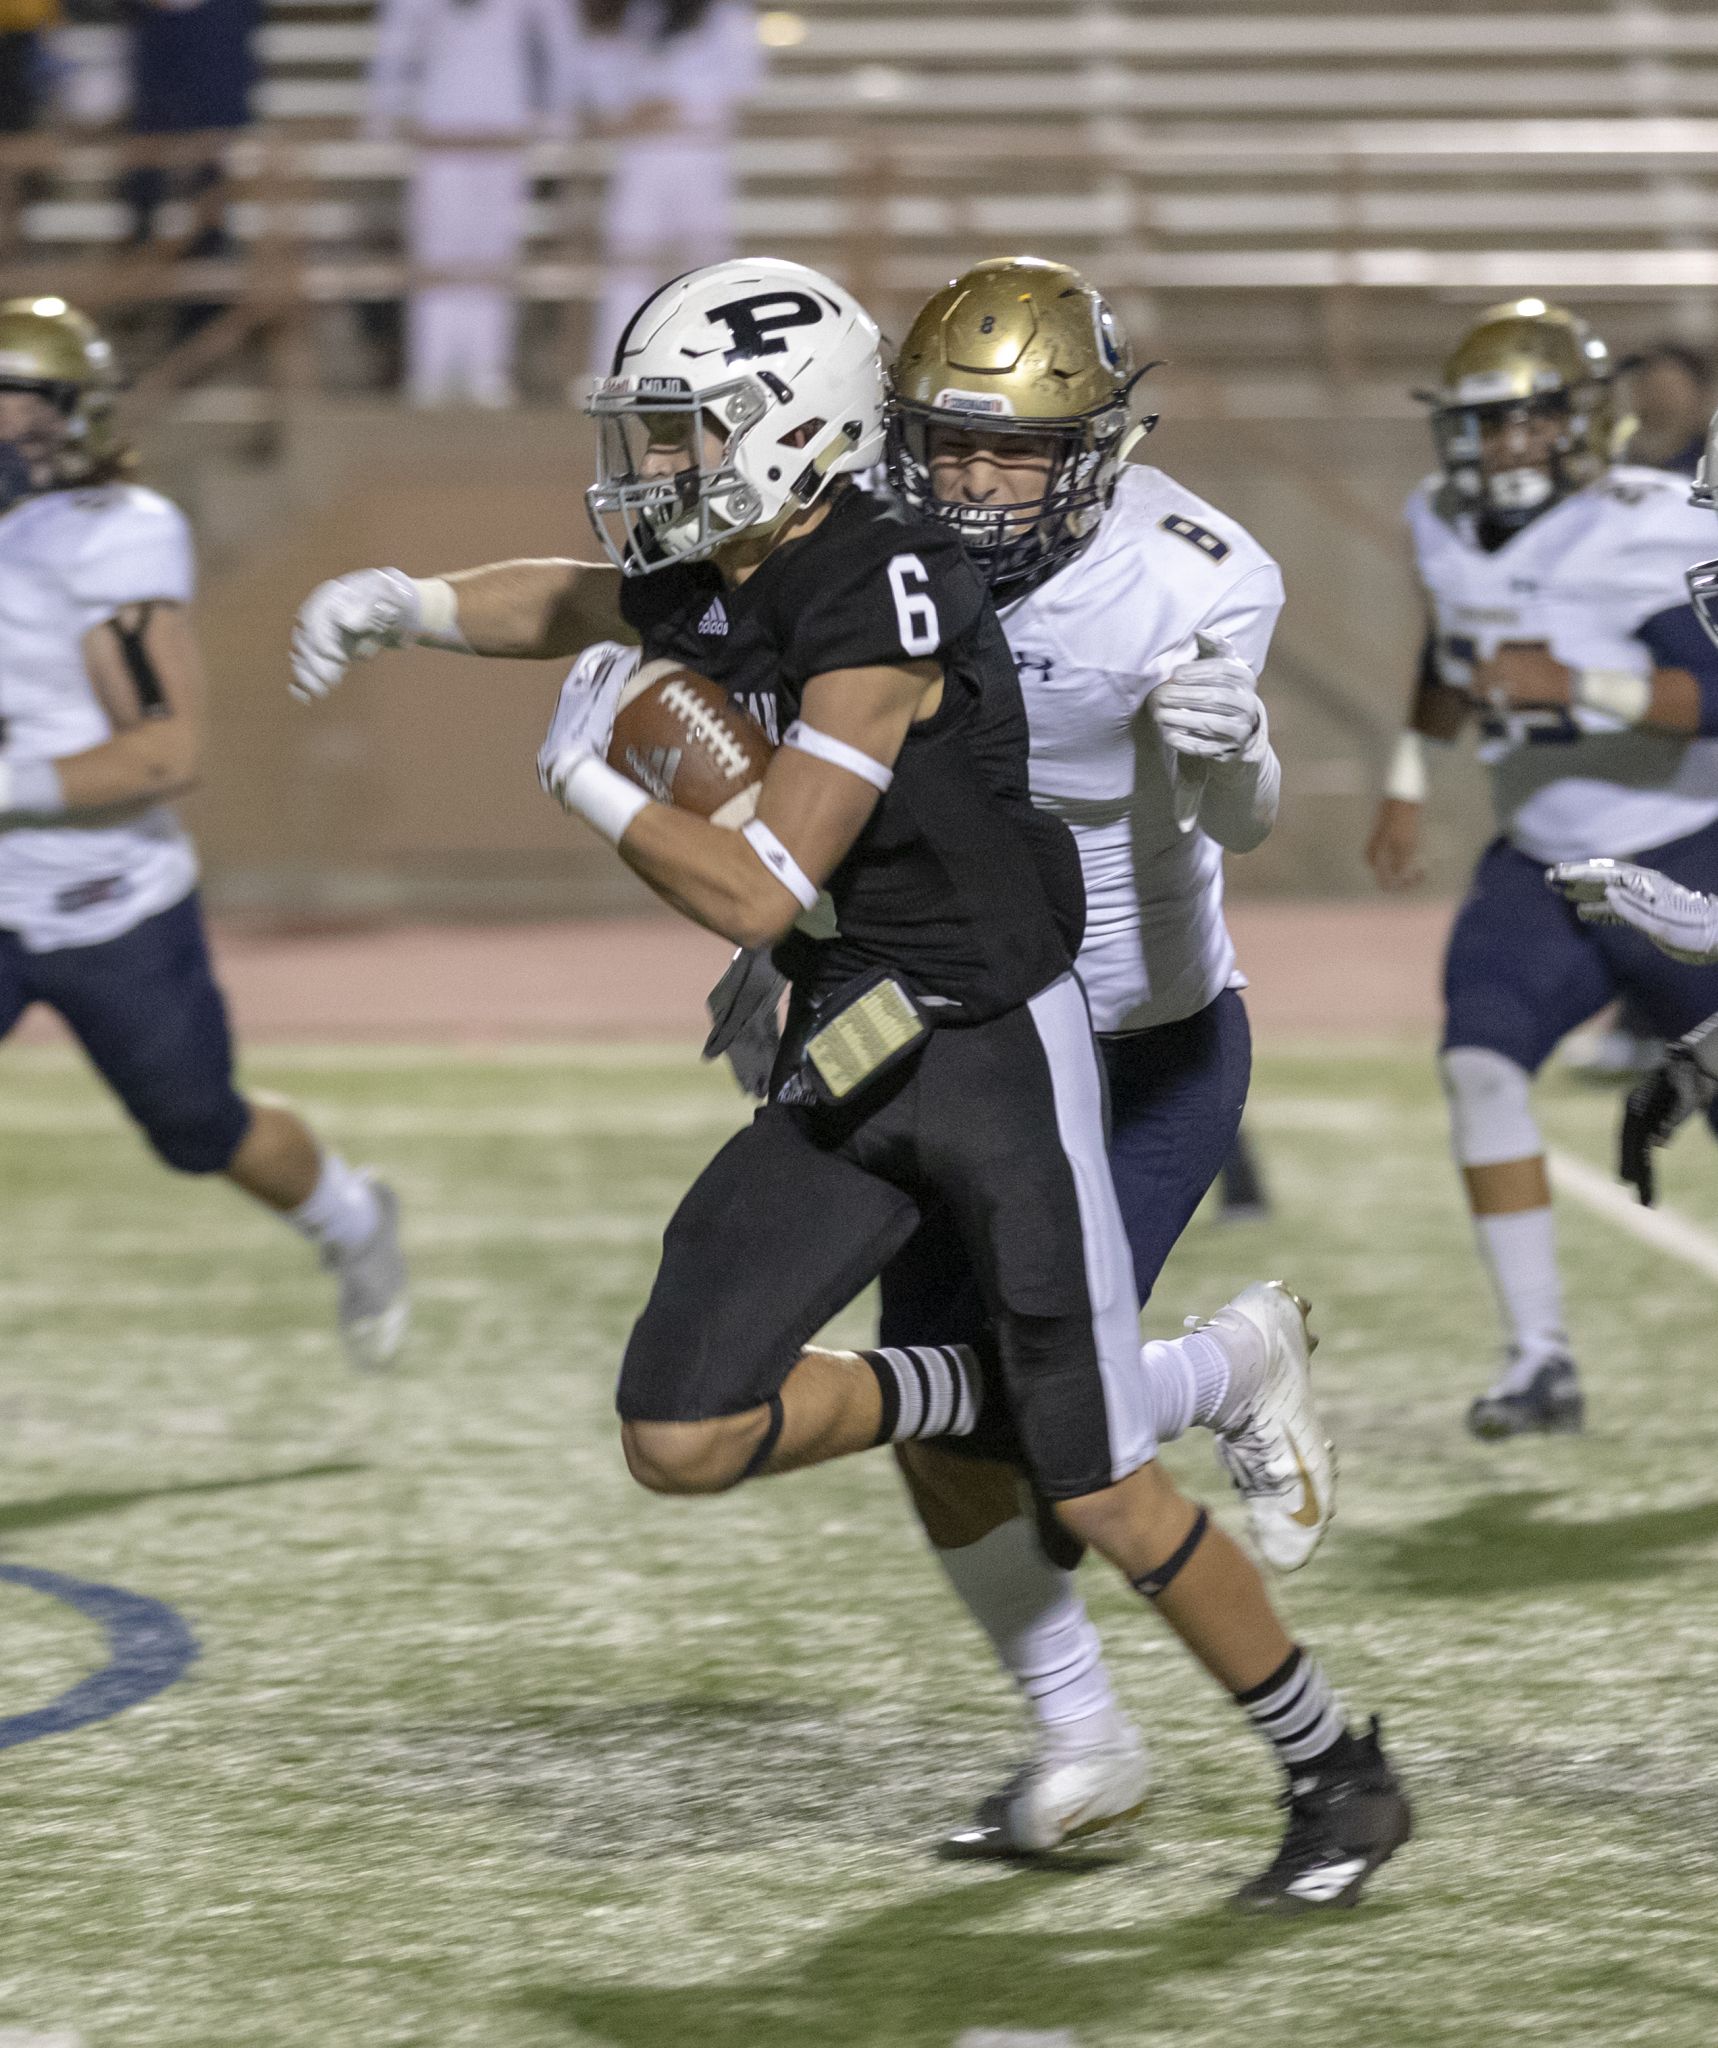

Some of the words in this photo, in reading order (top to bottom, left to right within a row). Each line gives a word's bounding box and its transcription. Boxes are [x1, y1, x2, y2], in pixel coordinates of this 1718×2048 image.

[705, 291, 823, 366] P
[981, 315, 995, 335] 8
[887, 553, 940, 657] 6
